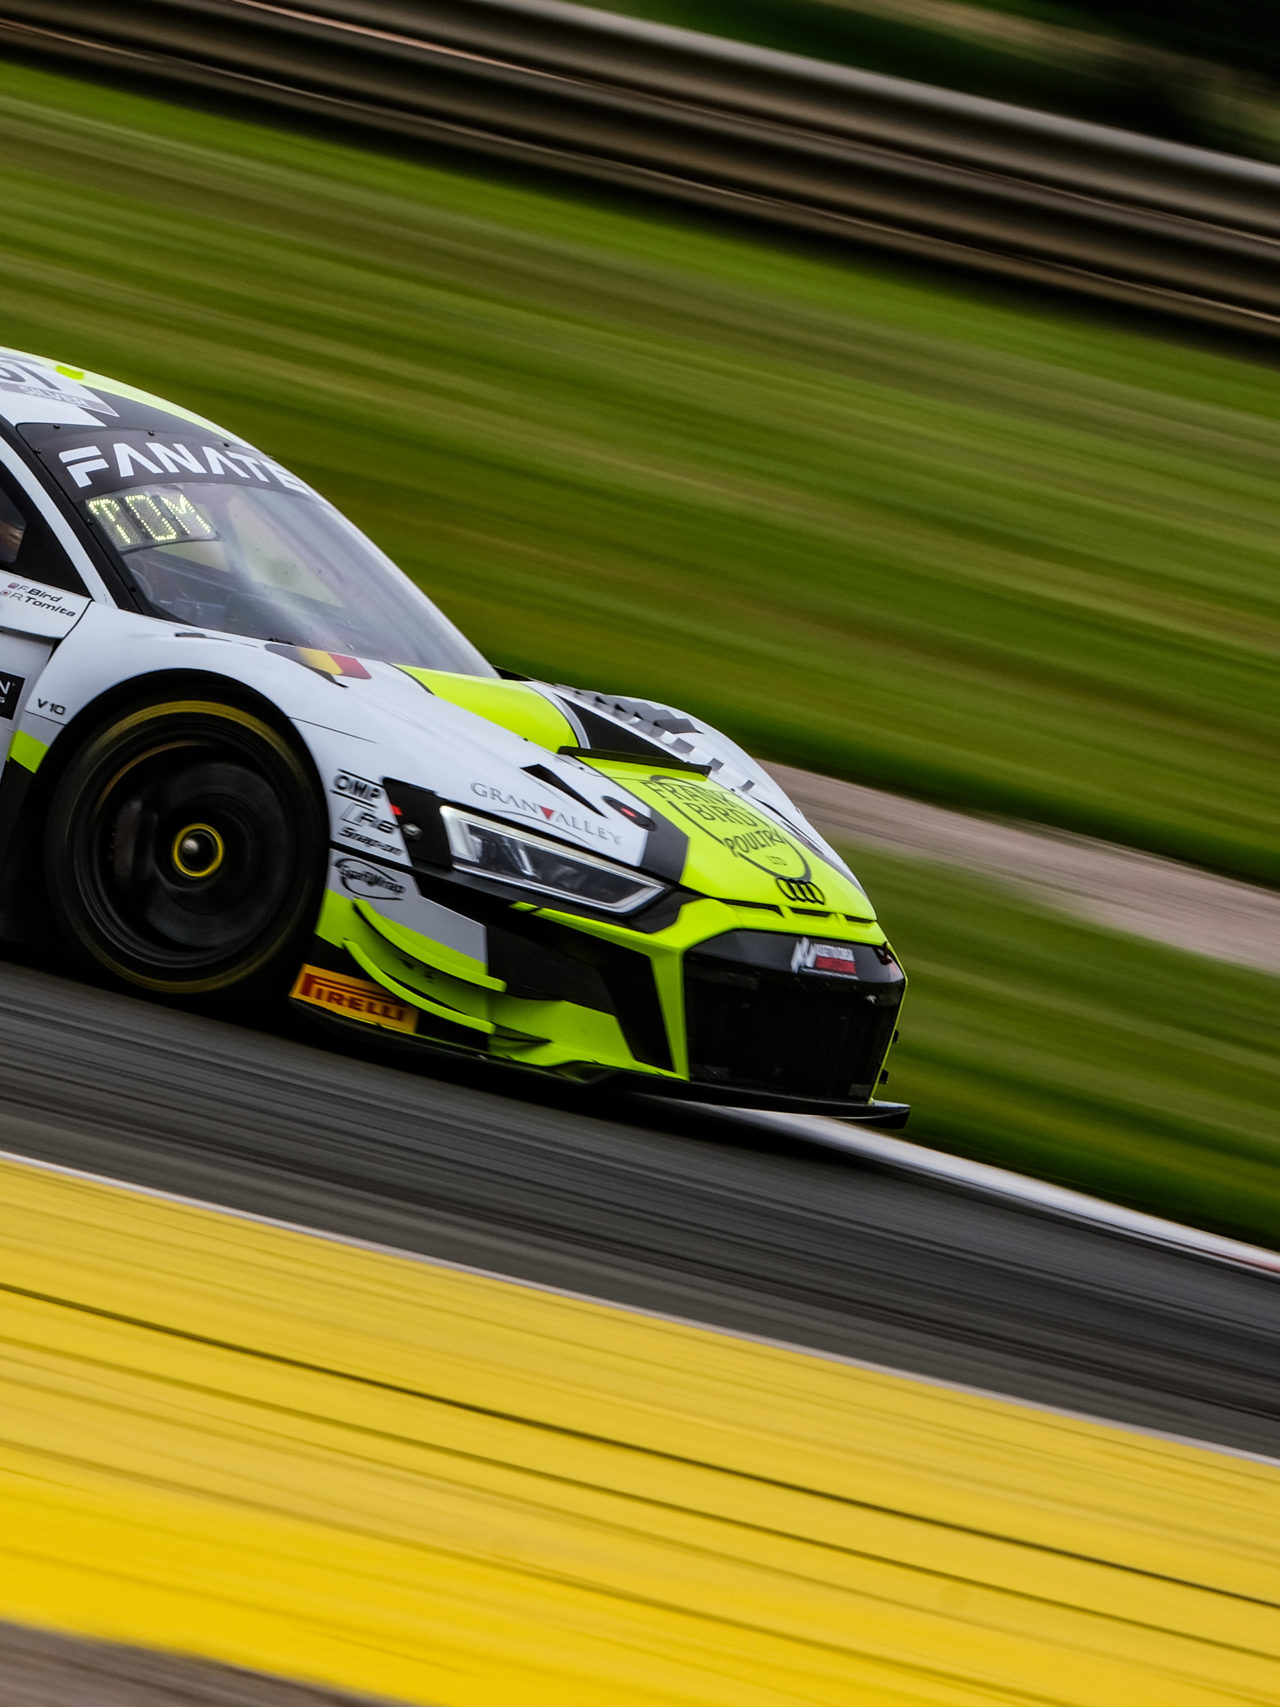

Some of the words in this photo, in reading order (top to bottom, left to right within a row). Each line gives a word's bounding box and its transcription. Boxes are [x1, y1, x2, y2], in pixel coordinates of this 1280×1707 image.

[59, 442, 312, 489] FANATE
[88, 494, 212, 544] TOM
[25, 596, 76, 617] Tomita
[28, 588, 63, 602] Bird
[723, 829, 786, 857] POULTRY
[300, 972, 408, 1023] PIRELLI
